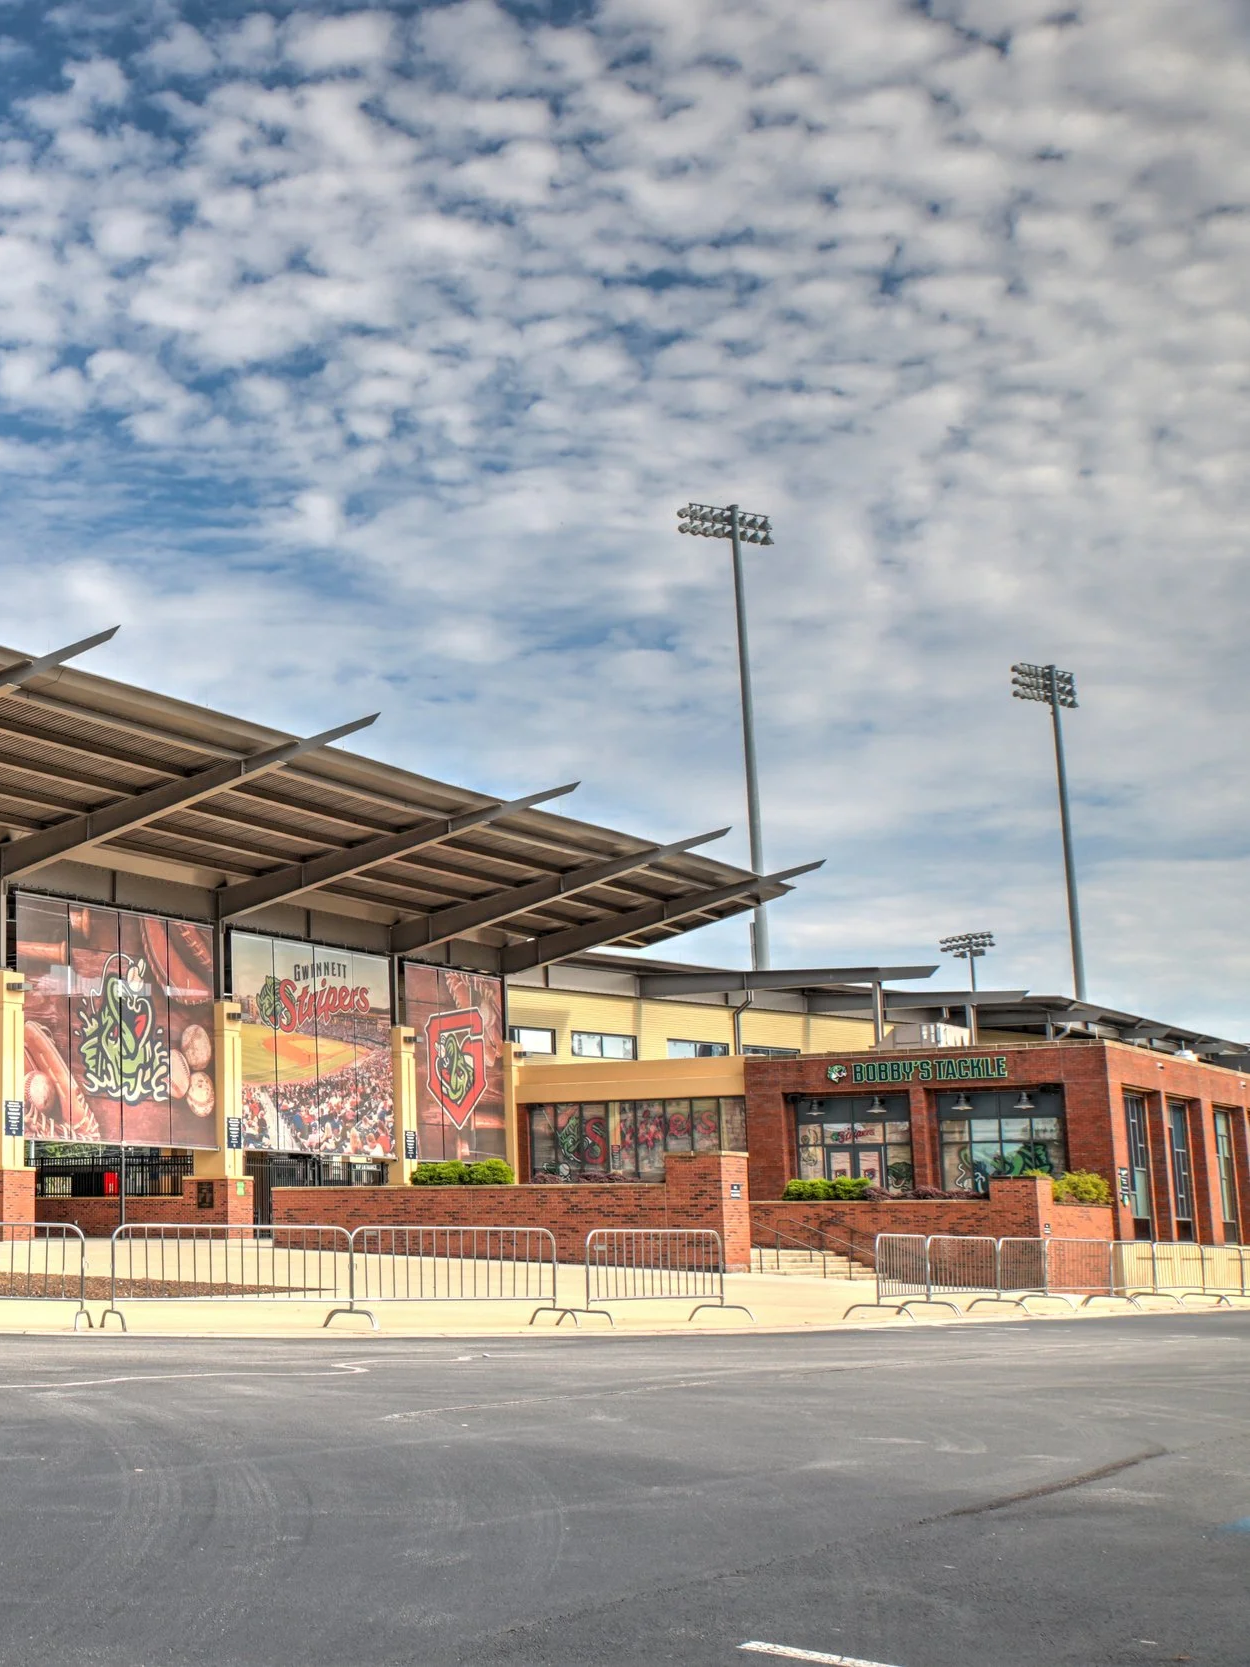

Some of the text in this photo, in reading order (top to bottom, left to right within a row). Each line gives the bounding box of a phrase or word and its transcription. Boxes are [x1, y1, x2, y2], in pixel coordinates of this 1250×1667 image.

[293, 961, 347, 982] GWINNETT
[279, 978, 370, 1034] Stripers
[852, 1056, 1008, 1084] BOBBY'S TACKLE
